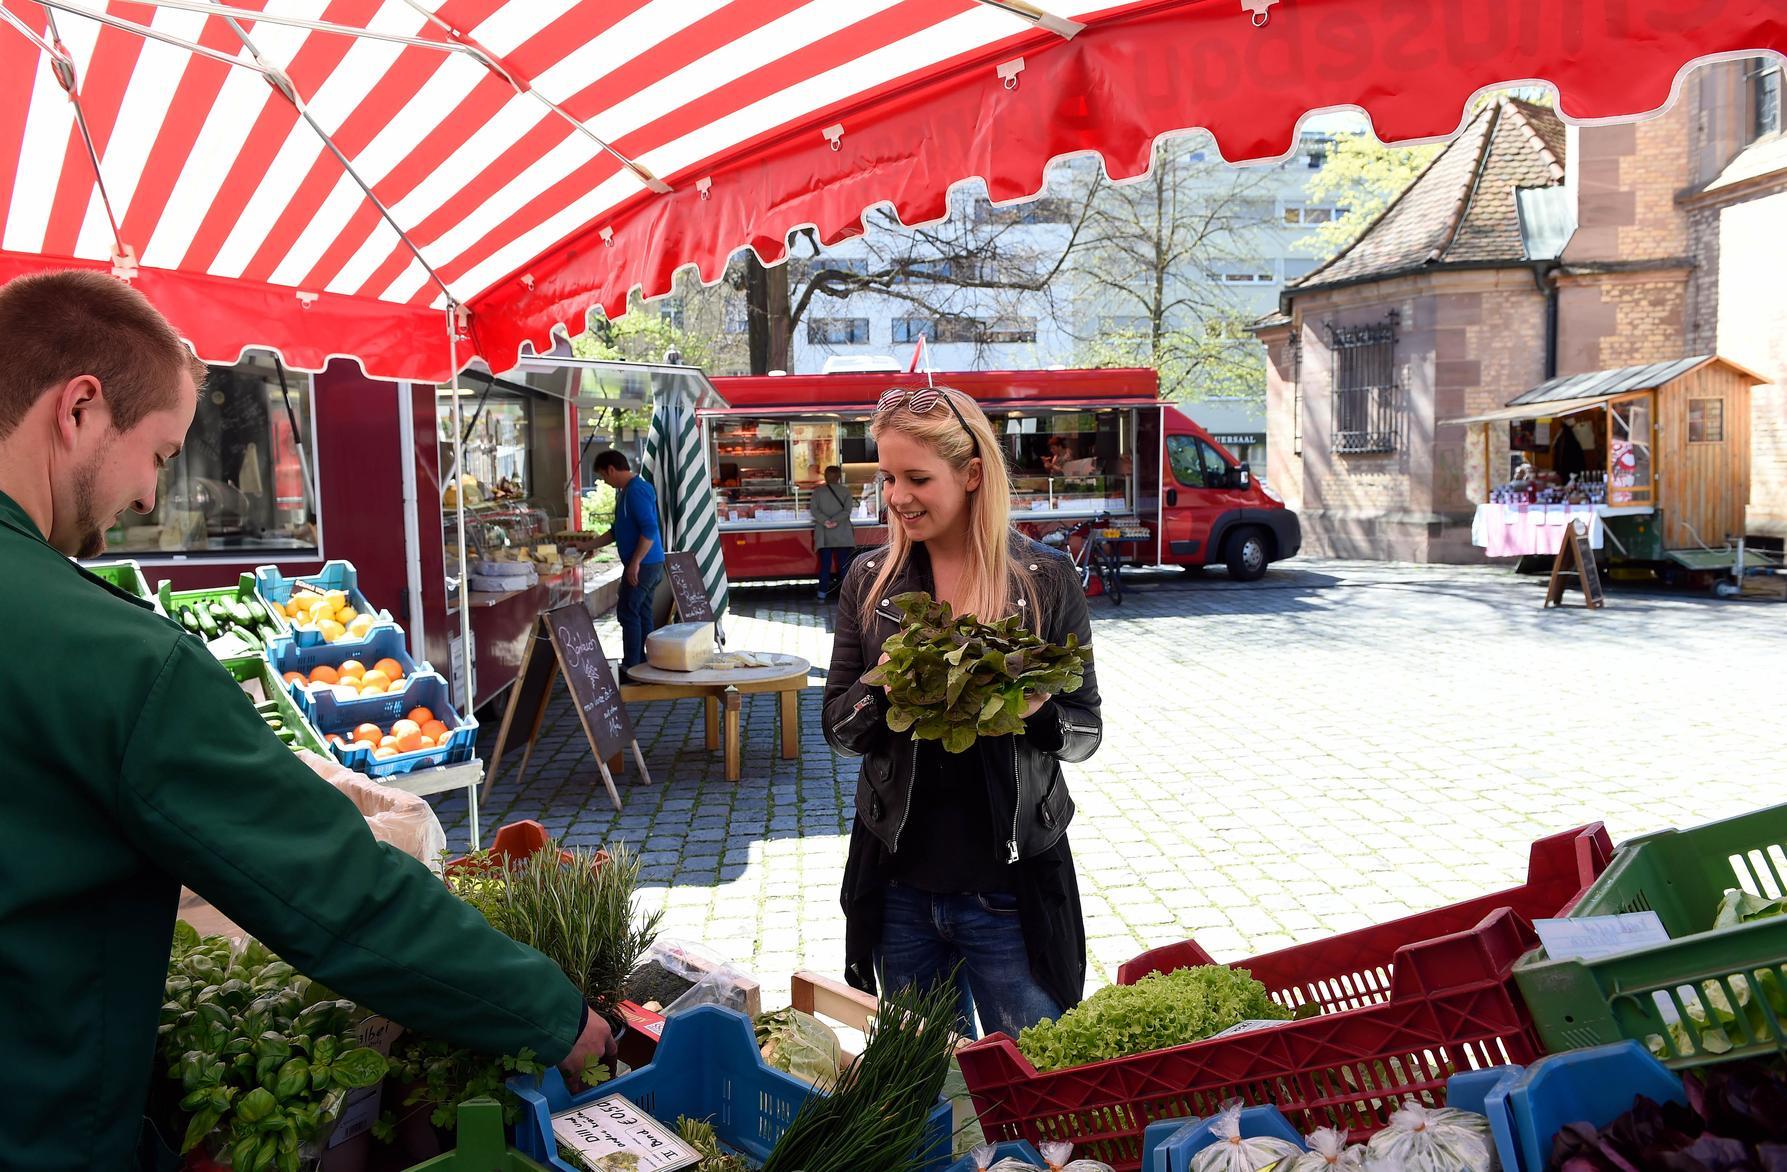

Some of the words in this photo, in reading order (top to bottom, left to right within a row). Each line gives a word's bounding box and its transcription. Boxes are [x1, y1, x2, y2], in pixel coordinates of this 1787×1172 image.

[565, 1116, 582, 1128] und
[575, 1129, 600, 1143] Dill
[637, 1129, 663, 1148] Bund
